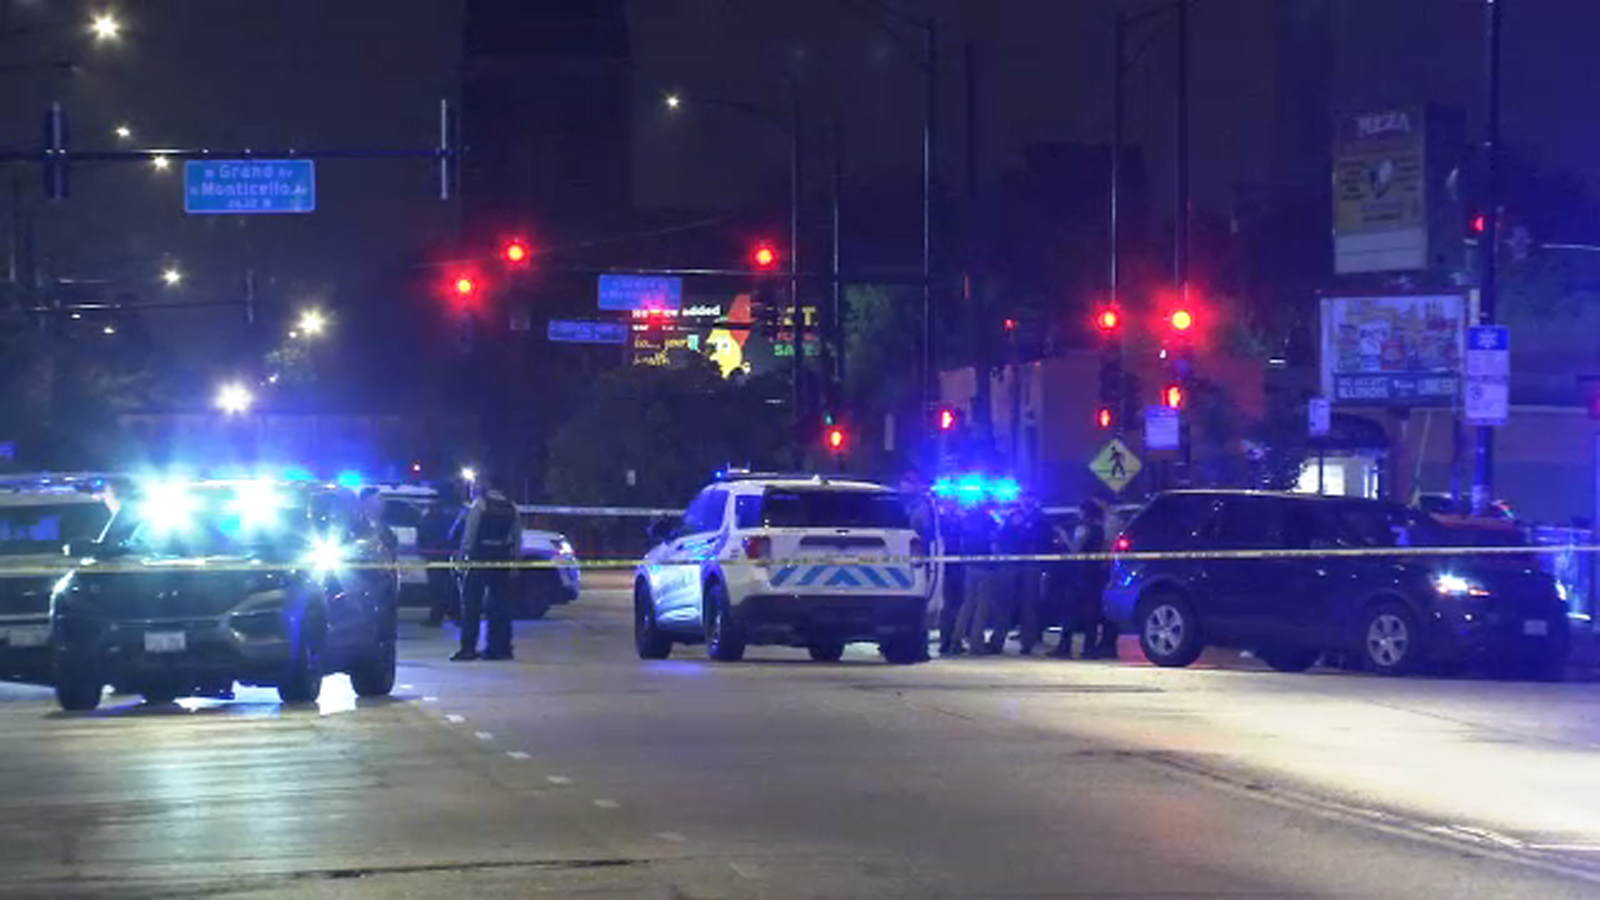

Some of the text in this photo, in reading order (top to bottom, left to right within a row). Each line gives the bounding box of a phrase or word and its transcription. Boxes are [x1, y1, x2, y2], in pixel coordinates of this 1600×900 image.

[219, 164, 274, 179] Grand
[278, 167, 294, 179] Av
[201, 181, 290, 196] Monticello
[682, 304, 720, 316] added
